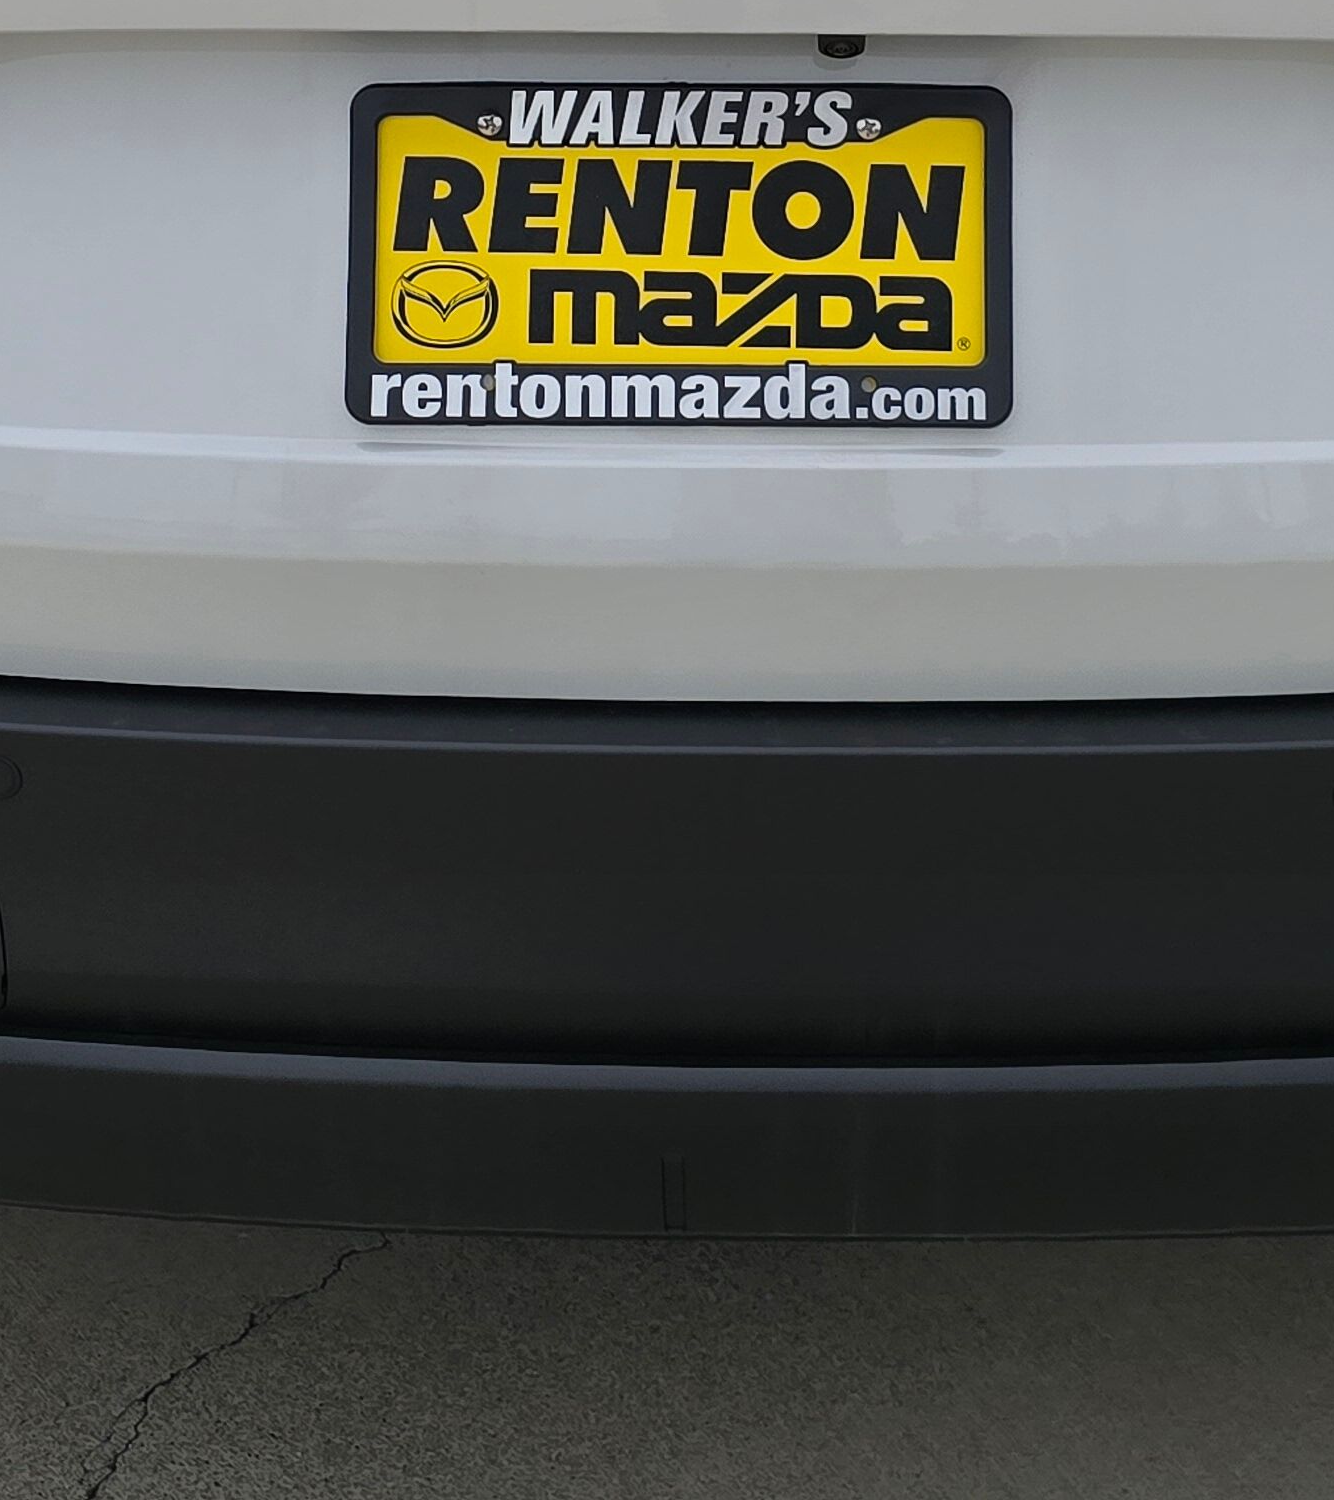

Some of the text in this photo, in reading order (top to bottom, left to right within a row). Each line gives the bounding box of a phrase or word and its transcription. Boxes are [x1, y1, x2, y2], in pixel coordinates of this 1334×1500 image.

[508, 89, 851, 147] WALKER'S
[392, 156, 965, 261] RENTON
[370, 361, 987, 421] rentonmazda.com
